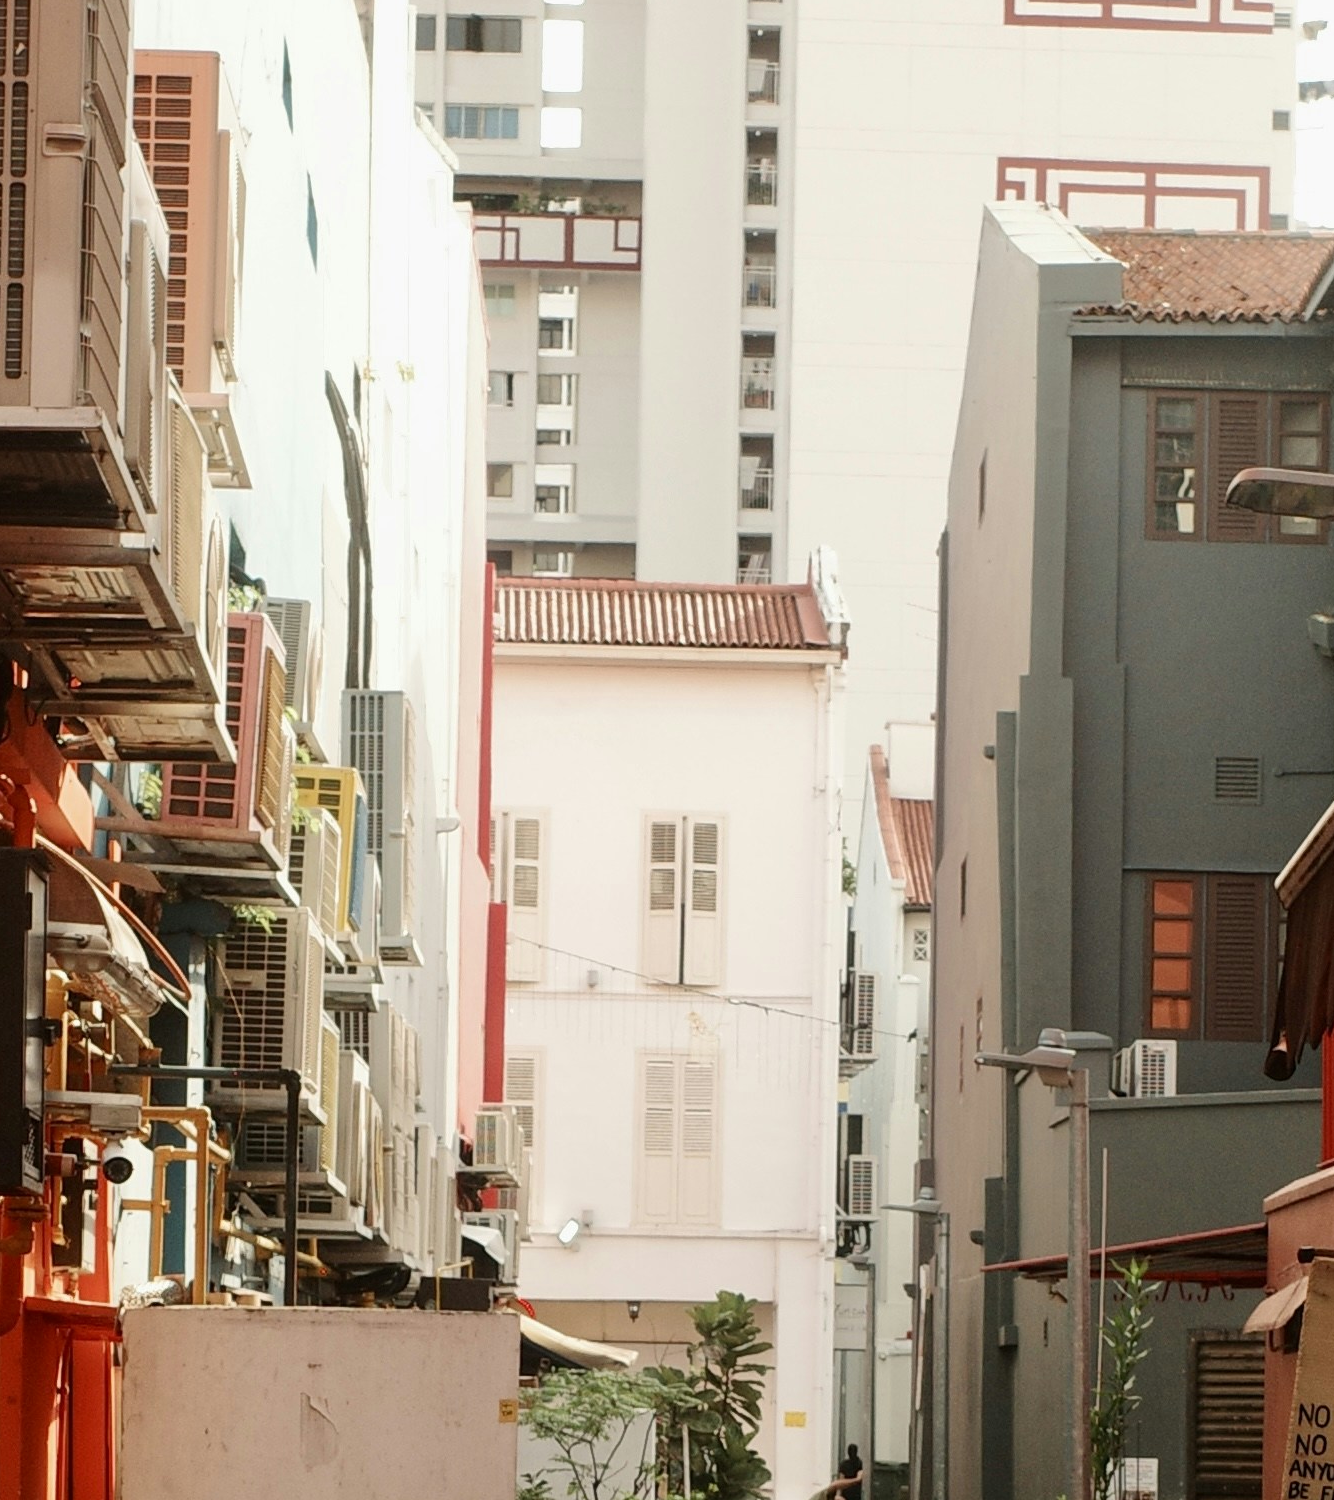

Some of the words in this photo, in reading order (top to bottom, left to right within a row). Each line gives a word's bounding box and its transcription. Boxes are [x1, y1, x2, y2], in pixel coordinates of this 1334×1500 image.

[1298, 1403, 1331, 1428] NO
[1295, 1434, 1327, 1456] NO
[1288, 1481, 1310, 1500] BE
